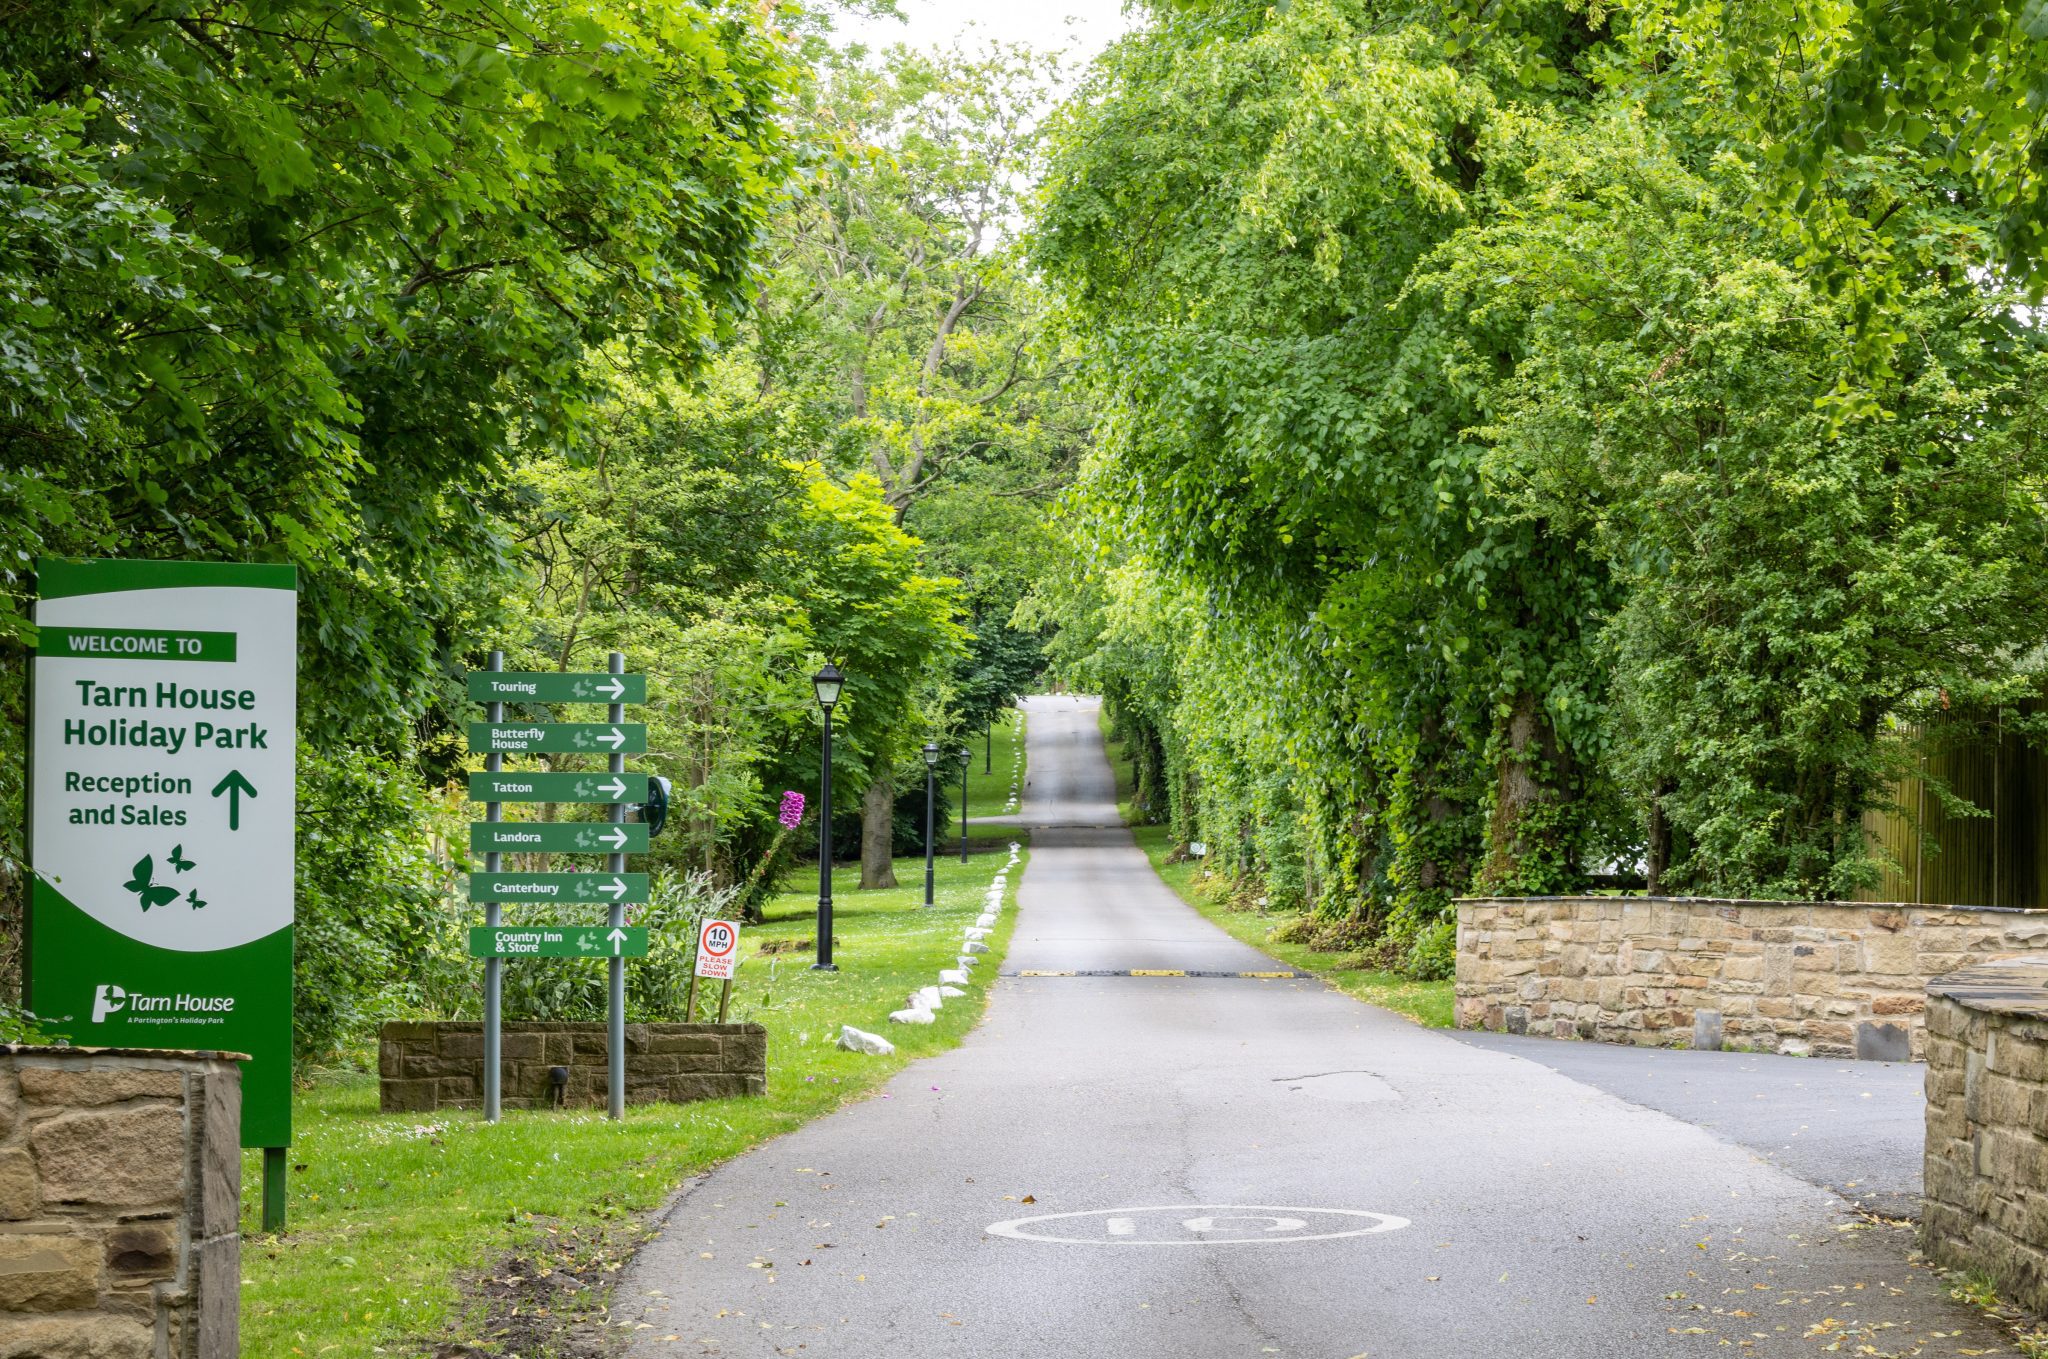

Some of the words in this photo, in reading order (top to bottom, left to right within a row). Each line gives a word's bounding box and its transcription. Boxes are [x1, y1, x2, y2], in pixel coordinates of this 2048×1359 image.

[68, 635, 168, 654] WELCOME
[176, 638, 202, 655] TO
[491, 681, 537, 695] Touring
[76, 680, 147, 708] Tarn
[156, 682, 256, 710] House
[64, 718, 187, 755] Holiday
[195, 722, 268, 749] Park
[491, 728, 545, 741] Butterfly
[491, 739, 528, 749] House
[65, 771, 192, 798] Reception
[492, 782, 533, 793] Tatton
[69, 804, 115, 825] and
[121, 804, 187, 826] Sales
[494, 832, 542, 842] Landora
[493, 883, 559, 896] Canterbury
[495, 931, 542, 945] Country
[544, 931, 563, 942] Inn
[711, 928, 728, 941] 10
[495, 942, 506, 953] &
[508, 942, 539, 953] Store
[708, 940, 728, 949] MPH
[699, 956, 733, 965] PLEASE
[703, 963, 728, 971] SLOW
[701, 969, 728, 977] DOWN
[128, 993, 171, 1011] Tarn
[175, 993, 235, 1012] House
[134, 1016, 179, 1024] Partington's
[180, 1017, 206, 1025] Holiday
